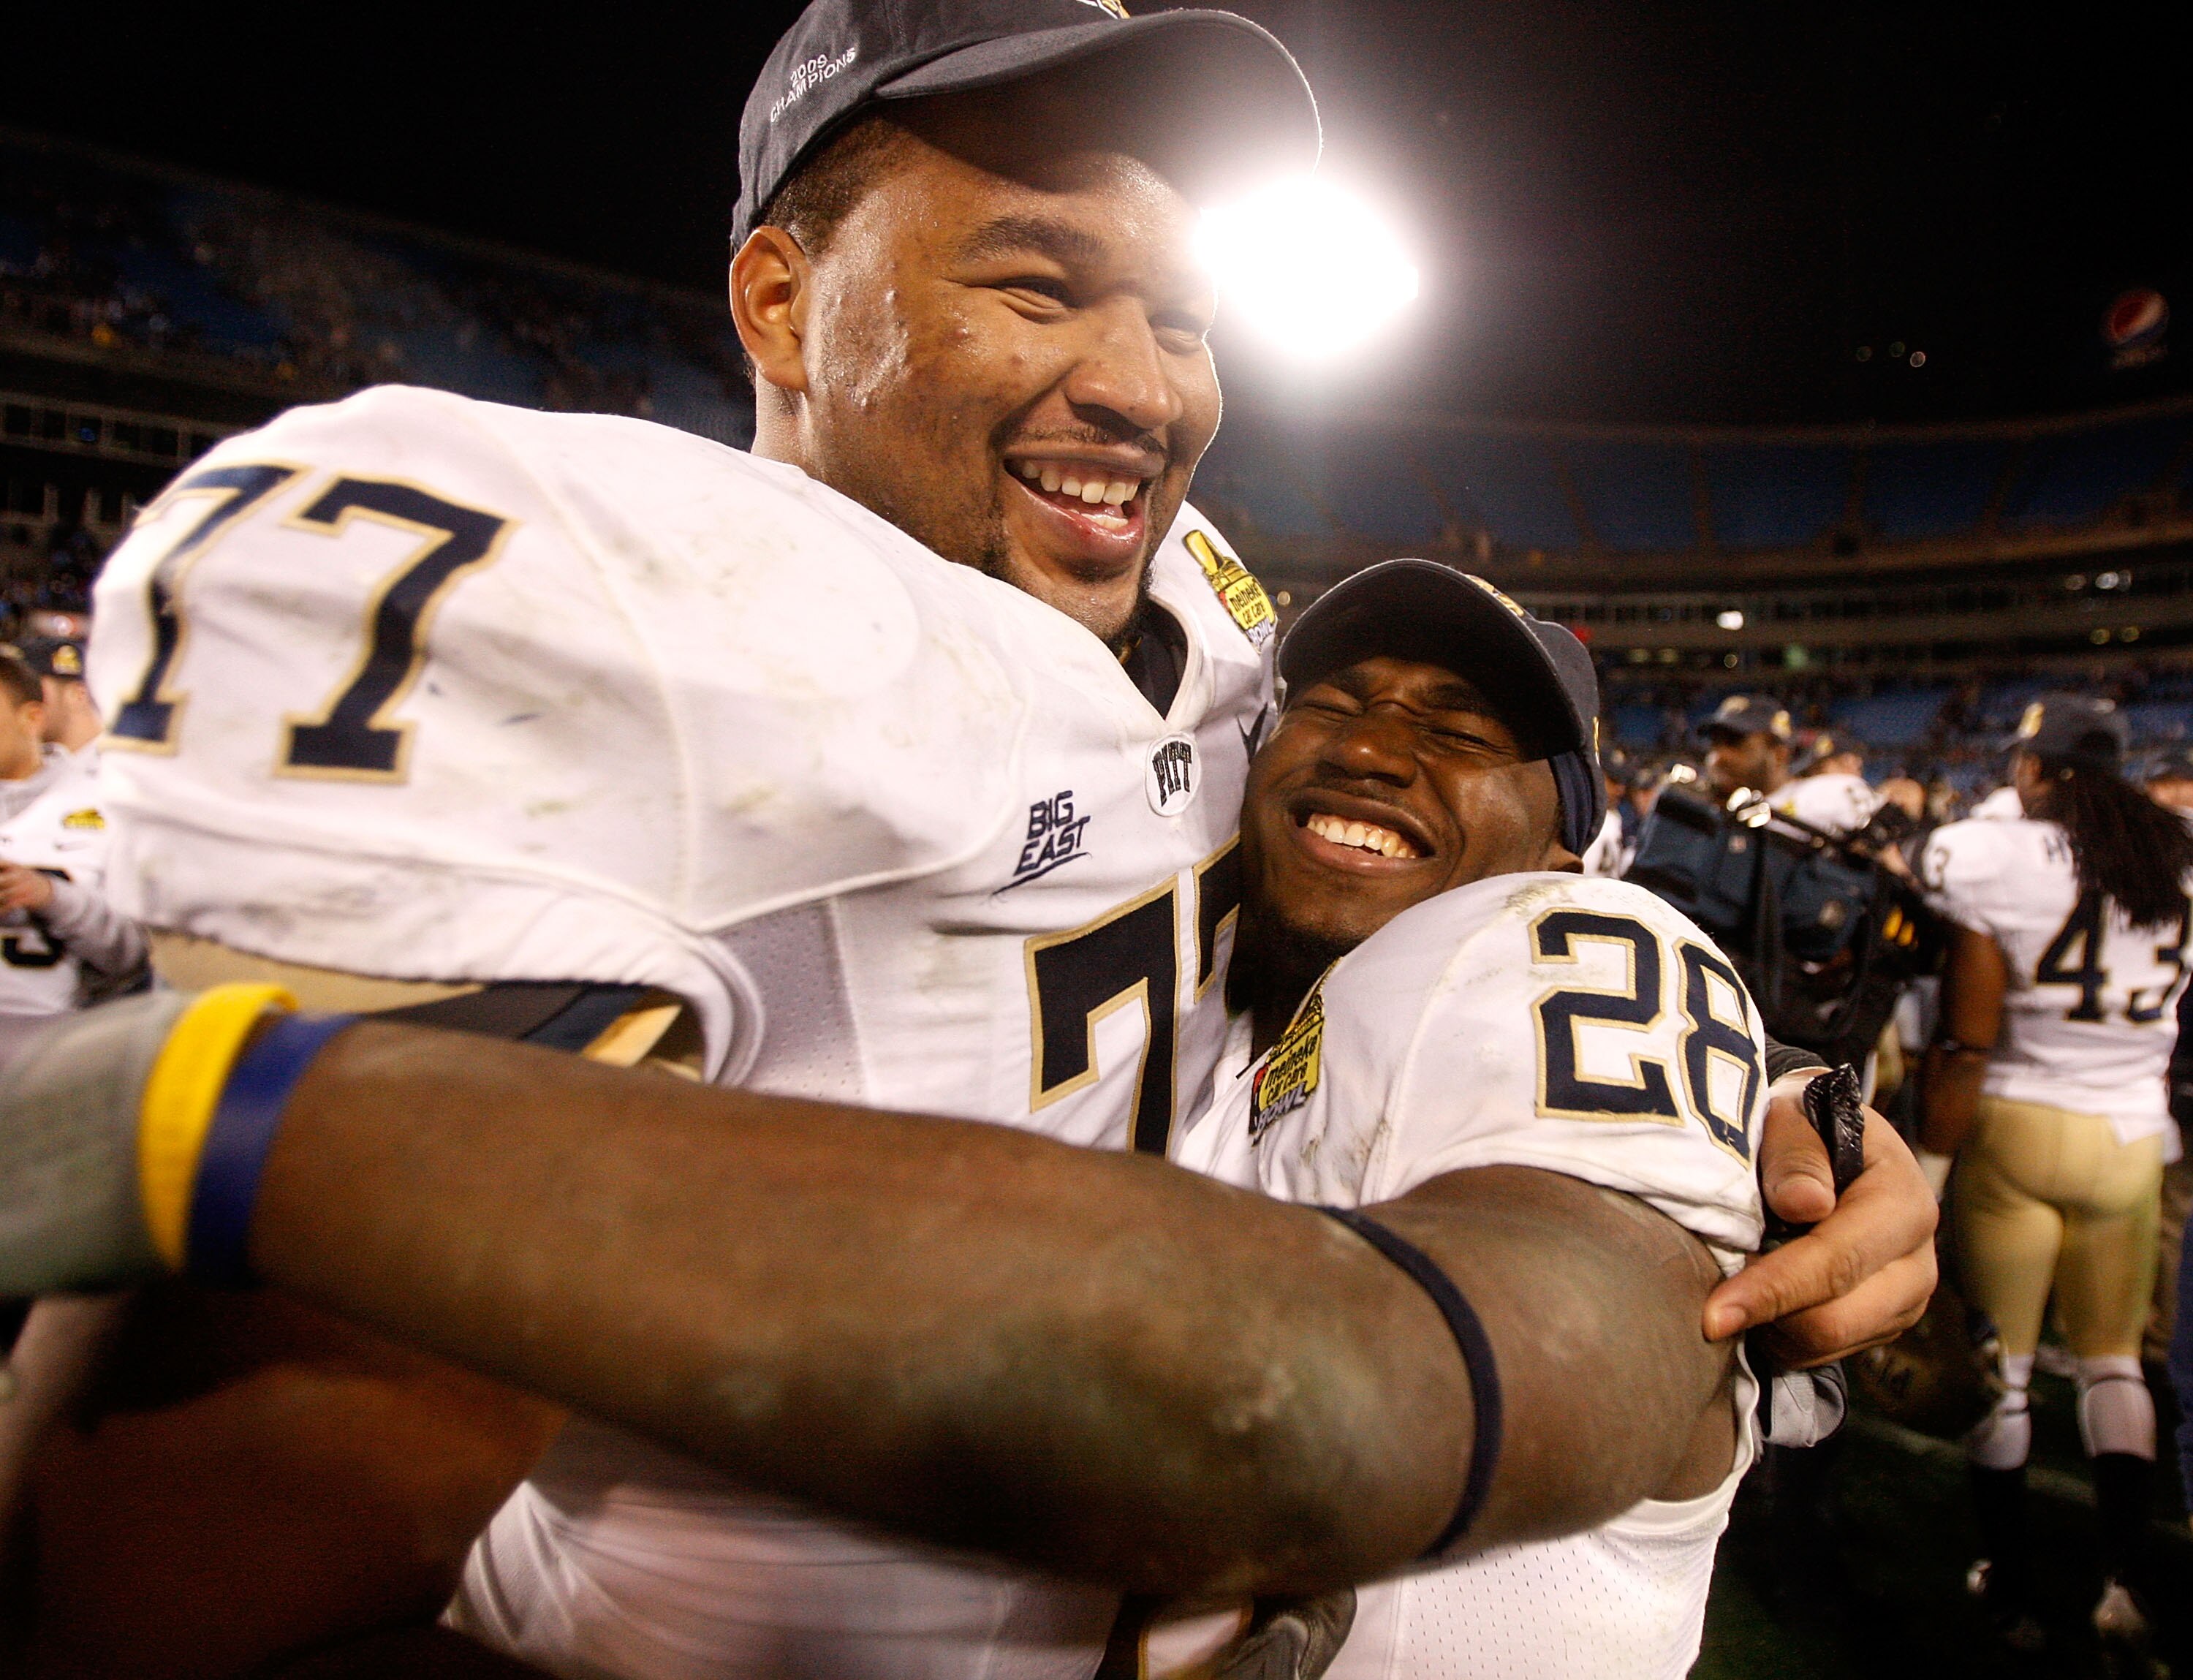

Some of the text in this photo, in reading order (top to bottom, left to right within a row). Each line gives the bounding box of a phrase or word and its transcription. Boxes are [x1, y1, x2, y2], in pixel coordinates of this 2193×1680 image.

[770, 48, 856, 123] CHAMPIONS
[790, 54, 830, 88] 2009
[97, 459, 523, 784] 77
[1152, 741, 1192, 807] PITT
[1013, 816, 1091, 876] EAST
[1026, 790, 1073, 840] BIG
[1528, 907, 1764, 1172] 28
